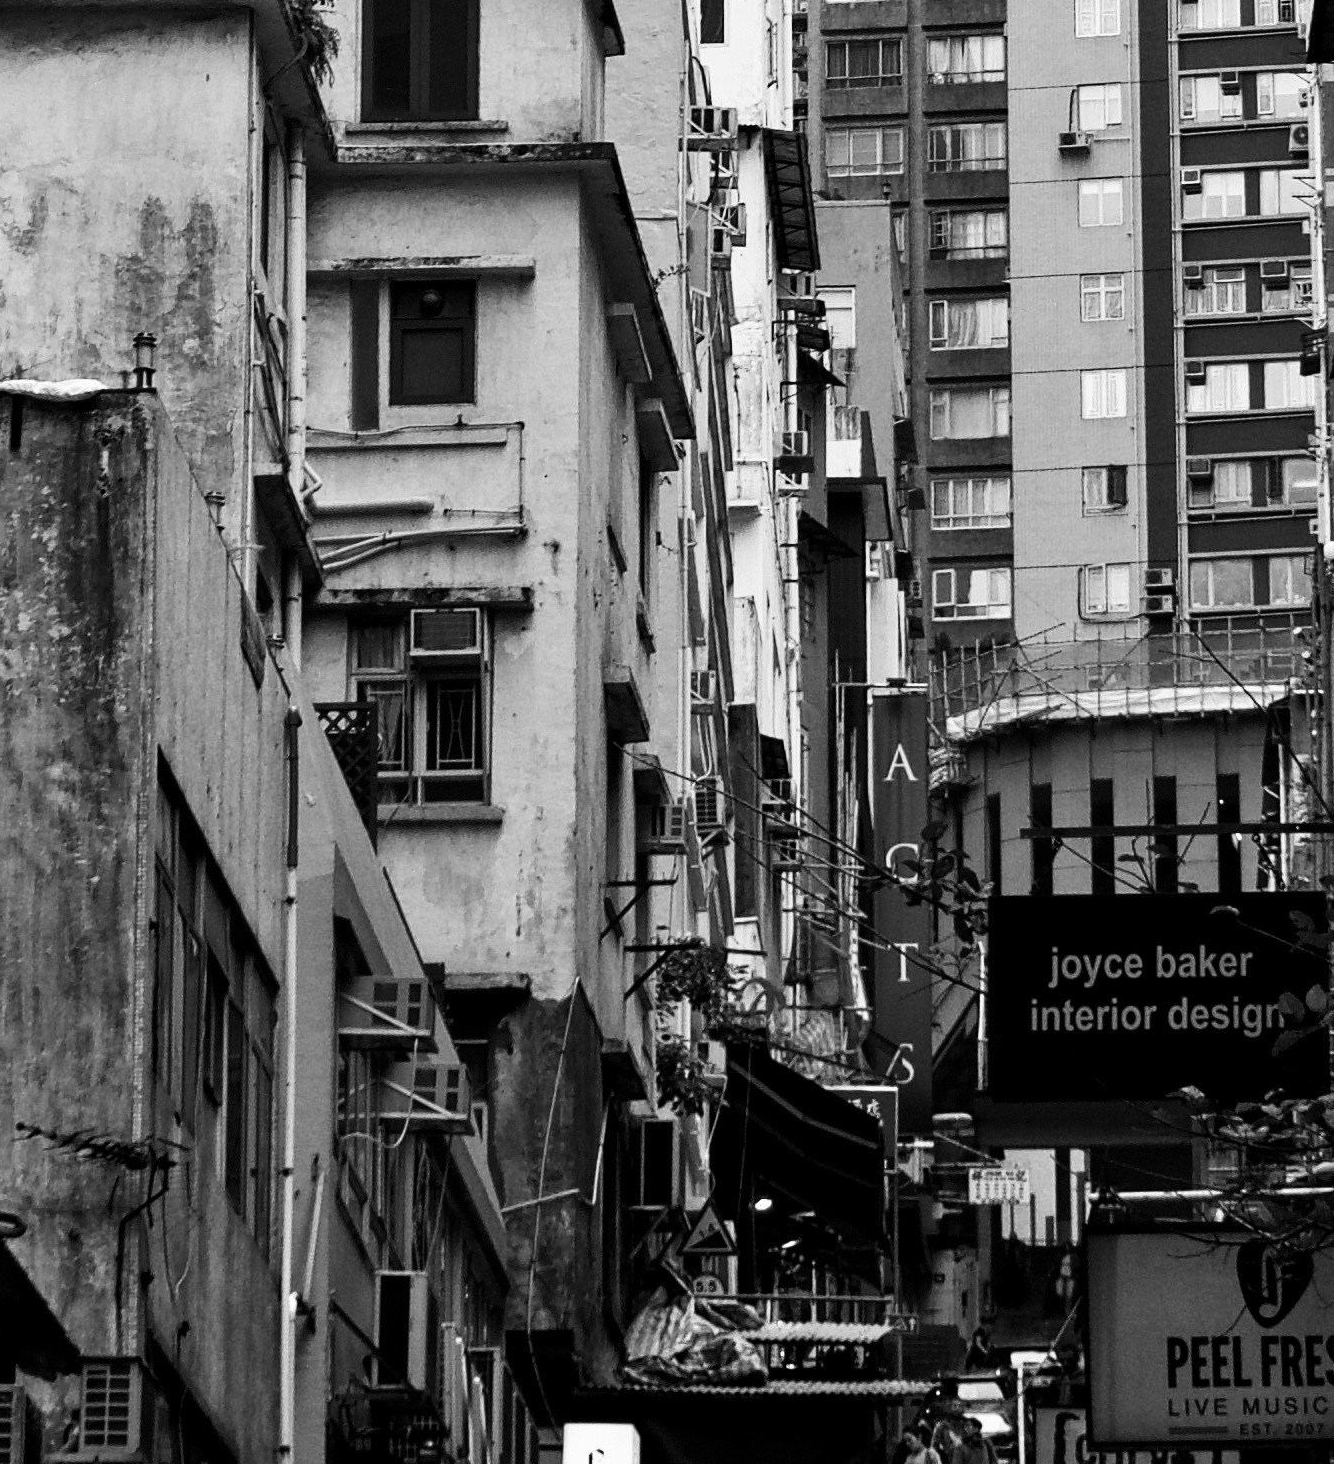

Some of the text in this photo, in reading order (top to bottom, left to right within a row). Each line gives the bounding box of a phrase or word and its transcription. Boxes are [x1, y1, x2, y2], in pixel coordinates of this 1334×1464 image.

[1048, 944, 1253, 988] joyce baker
[1031, 996, 1285, 1038] interior design
[1167, 1335, 1253, 1388] PEEL
[1168, 1397, 1228, 1417] LIVE
[1243, 1395, 1329, 1415] MUSIC
[1285, 1422, 1325, 1436] 2007
